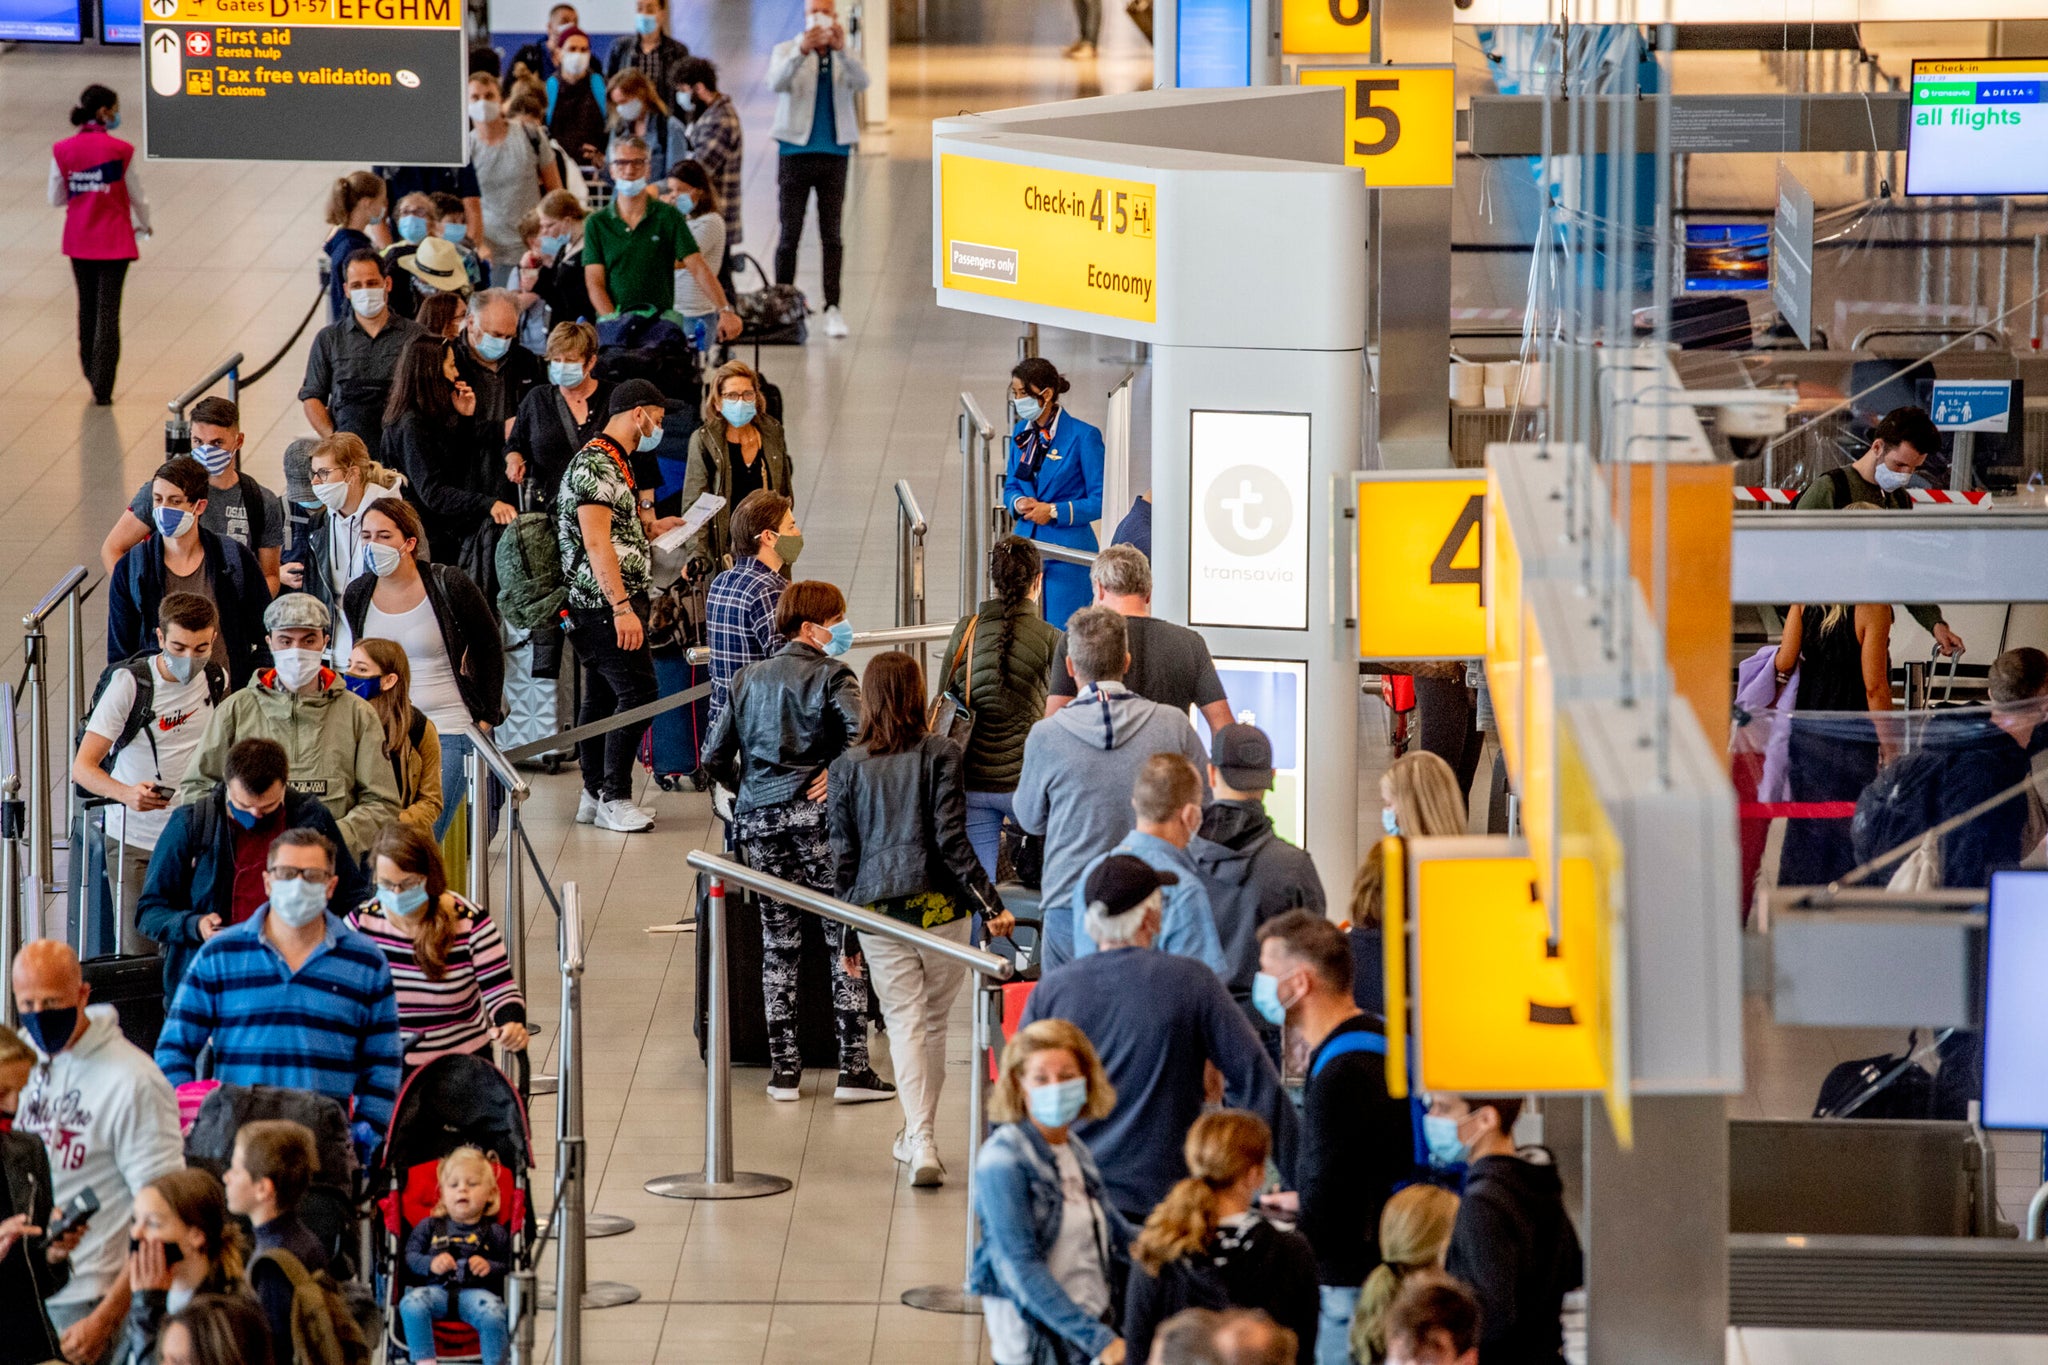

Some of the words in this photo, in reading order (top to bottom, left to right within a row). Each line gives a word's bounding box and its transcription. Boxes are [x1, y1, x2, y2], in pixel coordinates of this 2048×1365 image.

[217, 0, 264, 12] Gates
[216, 28, 257, 45] First
[261, 28, 291, 46] aid
[216, 47, 253, 58] Eerste
[254, 47, 282, 60] hulp
[216, 66, 251, 83] Tax
[254, 66, 294, 84] free
[297, 67, 392, 86] validation
[1935, 64, 1979, 73] Check-in
[217, 85, 266, 97] Customs
[1993, 89, 2024, 97] DELTA
[1354, 79, 1401, 156] 5
[1916, 107, 1943, 126] all
[1951, 107, 2021, 131] flights
[1024, 186, 1085, 218] Check-in
[1090, 189, 1104, 231] 4
[1115, 191, 1128, 235] 5
[953, 250, 996, 271] Passengers
[997, 258, 1015, 276] only
[1088, 263, 1152, 303] Economy
[1430, 494, 1487, 608] 4
[1203, 565, 1294, 582] transavia
